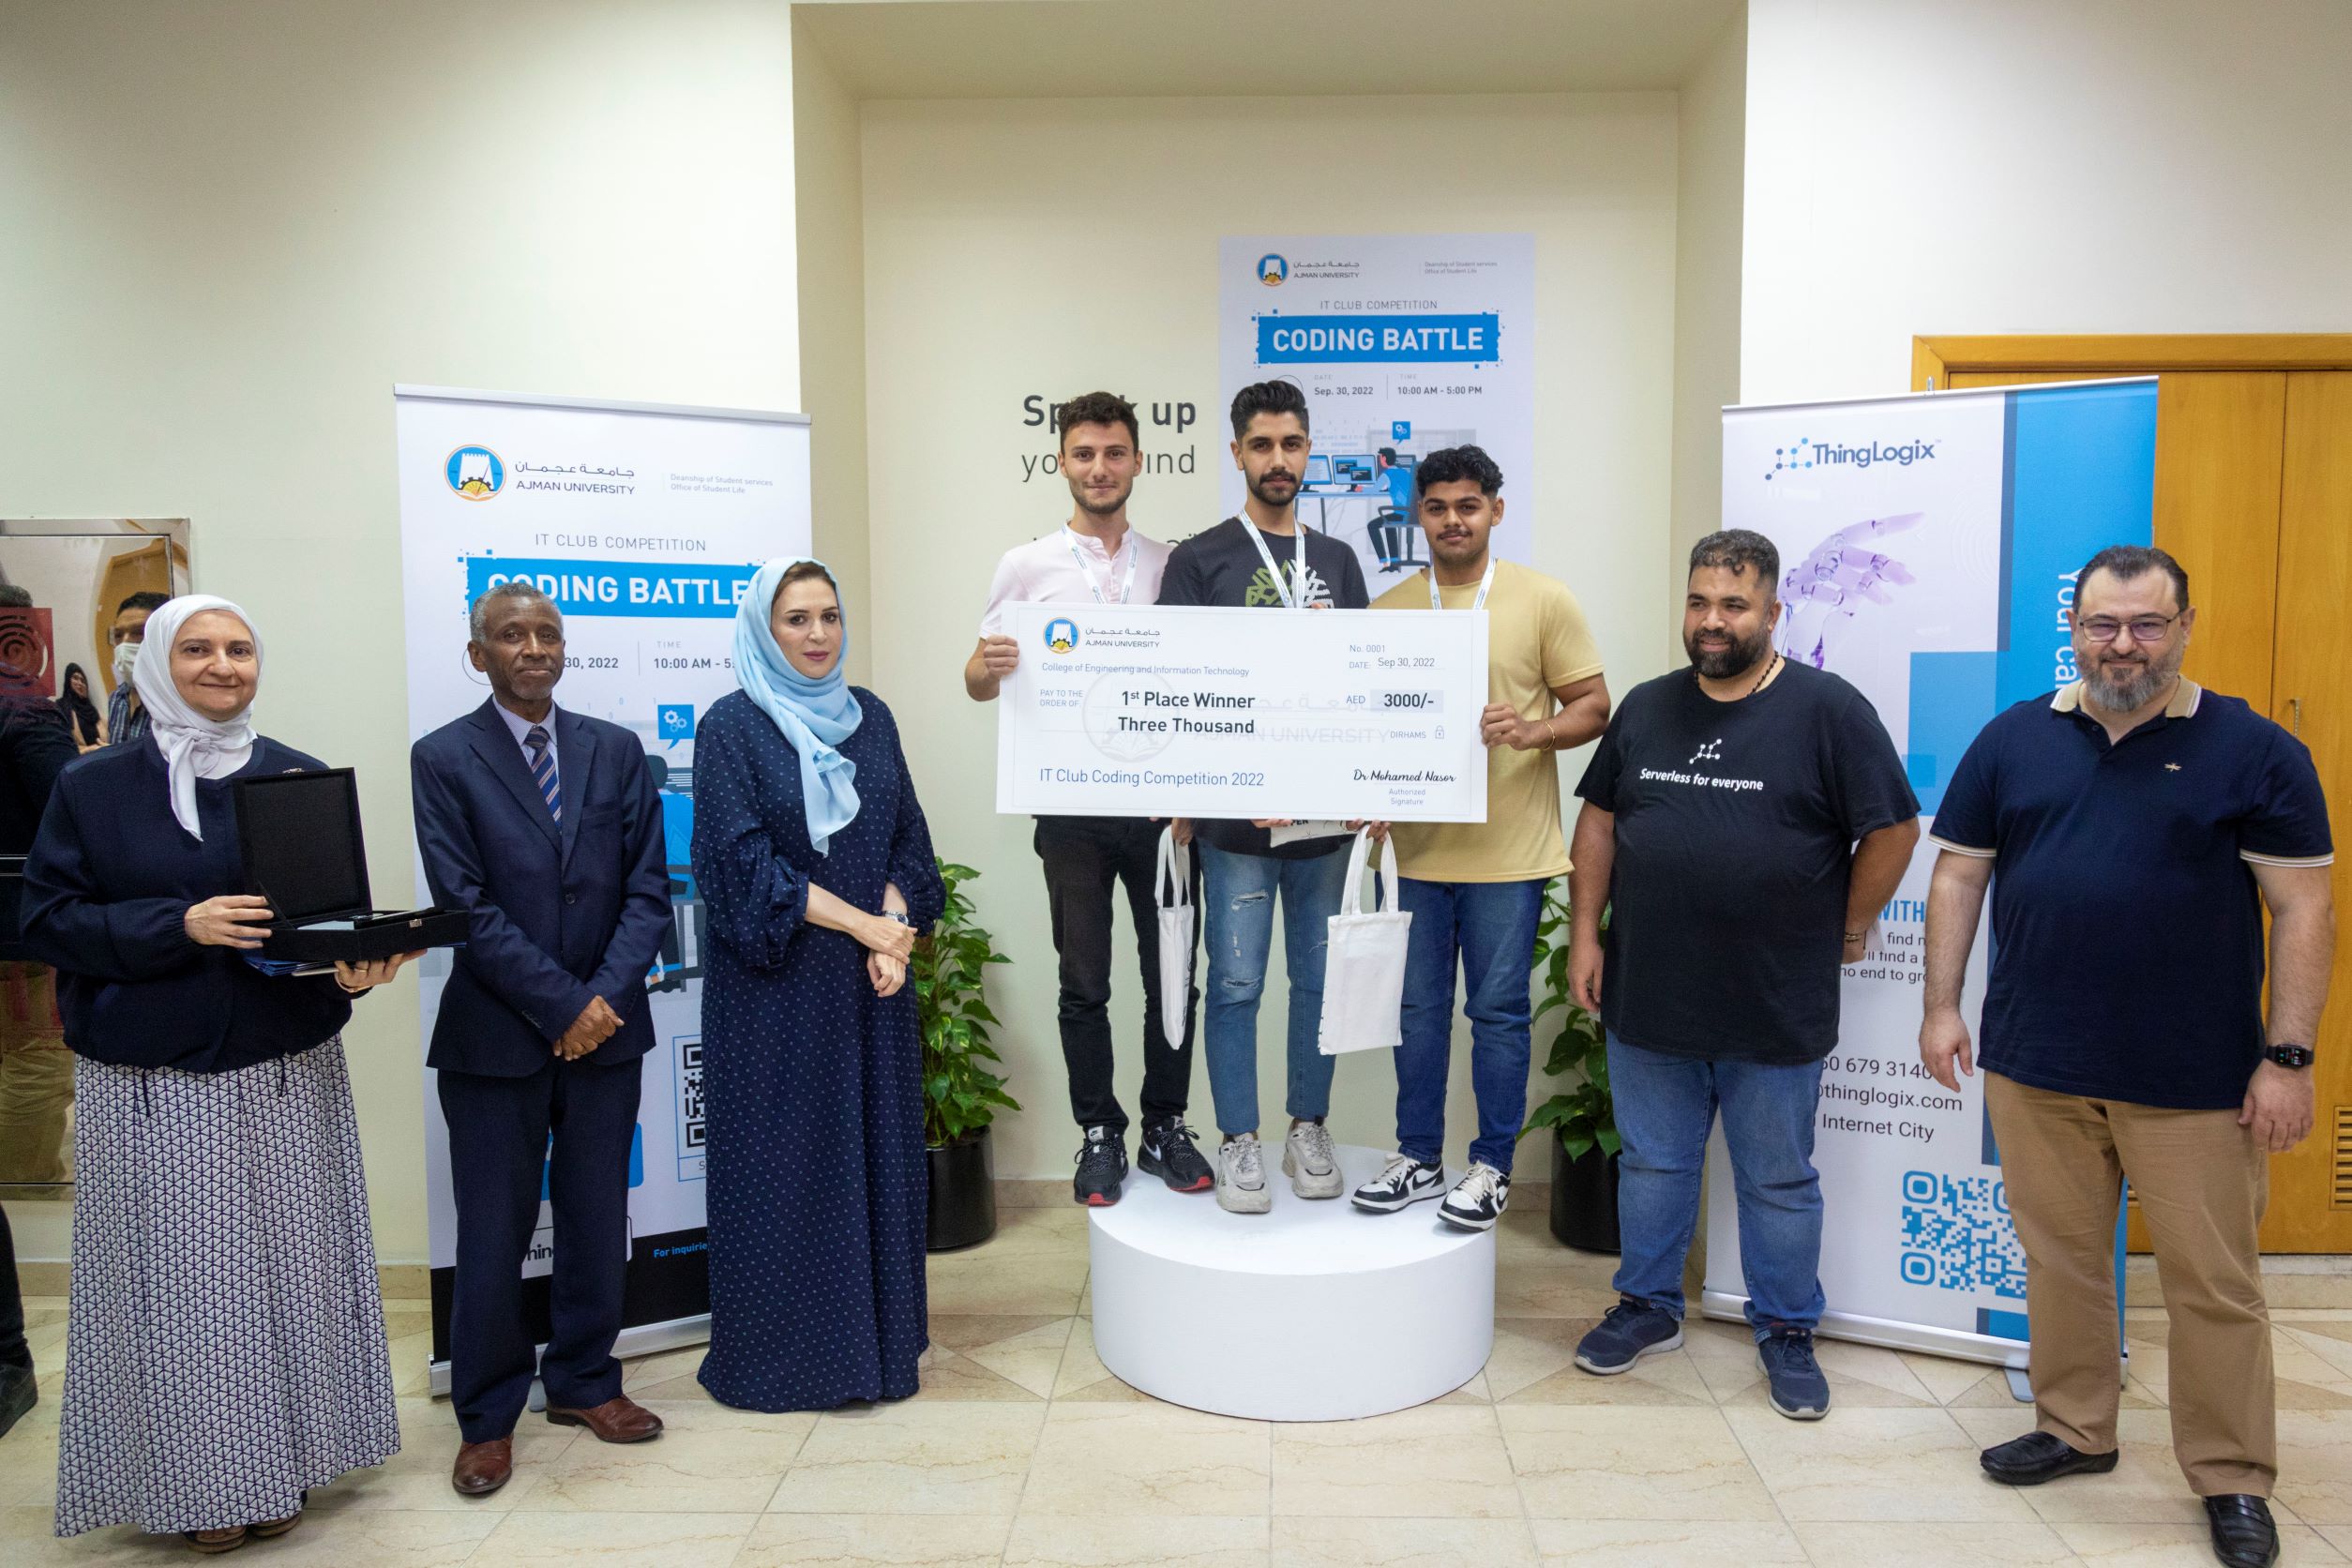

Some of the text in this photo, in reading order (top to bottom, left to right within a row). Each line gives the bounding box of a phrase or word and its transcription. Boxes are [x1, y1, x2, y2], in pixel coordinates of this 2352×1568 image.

[1320, 299, 1438, 309] IT CLUB COMPETITION
[1273, 327, 1484, 352] CODING BATTLE
[1314, 386, 1374, 398] Sep. 30, 2022
[1397, 386, 1422, 396] 10:00
[1424, 386, 1438, 395] AM
[1447, 386, 1466, 395] 5:00
[1469, 386, 1483, 395] PM
[1152, 401, 1197, 434] up
[1812, 439, 1936, 468] ThingLogix
[515, 461, 635, 479] جامعة عجمان
[1021, 445, 1195, 483] yo ind
[516, 480, 635, 495] AJMAN UNIVERSITY
[671, 474, 773, 487] Deanship of Student services
[671, 483, 746, 494] Office of Student Life
[535, 534, 706, 551] IT CLUB COMPETITION
[629, 577, 749, 606] BATTLE
[1124, 628, 1160, 637] جامعة
[656, 641, 682, 649] TIME
[588, 657, 619, 669] 2022
[654, 657, 688, 669] 10:00
[691, 658, 711, 669] AM
[1042, 662, 1250, 678] College of Engineering and Information Technology
[1378, 657, 1395, 669] Sep
[1397, 657, 1410, 668] 30,
[1413, 657, 1435, 667] 2022
[1056, 689, 1066, 698] TO
[1122, 691, 1140, 706] 1st
[1144, 691, 1189, 707] Place
[1193, 692, 1255, 709] Winner
[1346, 692, 1434, 709] AED 3000/-
[1039, 699, 1066, 707] ORDER
[1118, 716, 1255, 734] Three Thousand
[1271, 728, 1392, 744] UNIVERSITY
[1390, 731, 1426, 739] DIRHAMS
[1040, 768, 1264, 788] IT Club Coding Competition 2022
[1353, 768, 1369, 781] Dr
[1370, 769, 1424, 782] Mohamed
[1640, 768, 1764, 792] Serverless for everyone
[1389, 788, 1426, 796] Authorized
[1391, 798, 1424, 807] Signature
[1888, 932, 1913, 945] find
[1909, 955, 1918, 963] a
[1861, 968, 1885, 979] end
[1891, 969, 1904, 980] to
[1847, 1058, 1879, 1075] 679
[1823, 1113, 1935, 1143] Internet City
[654, 1242, 708, 1259] For inquirie
